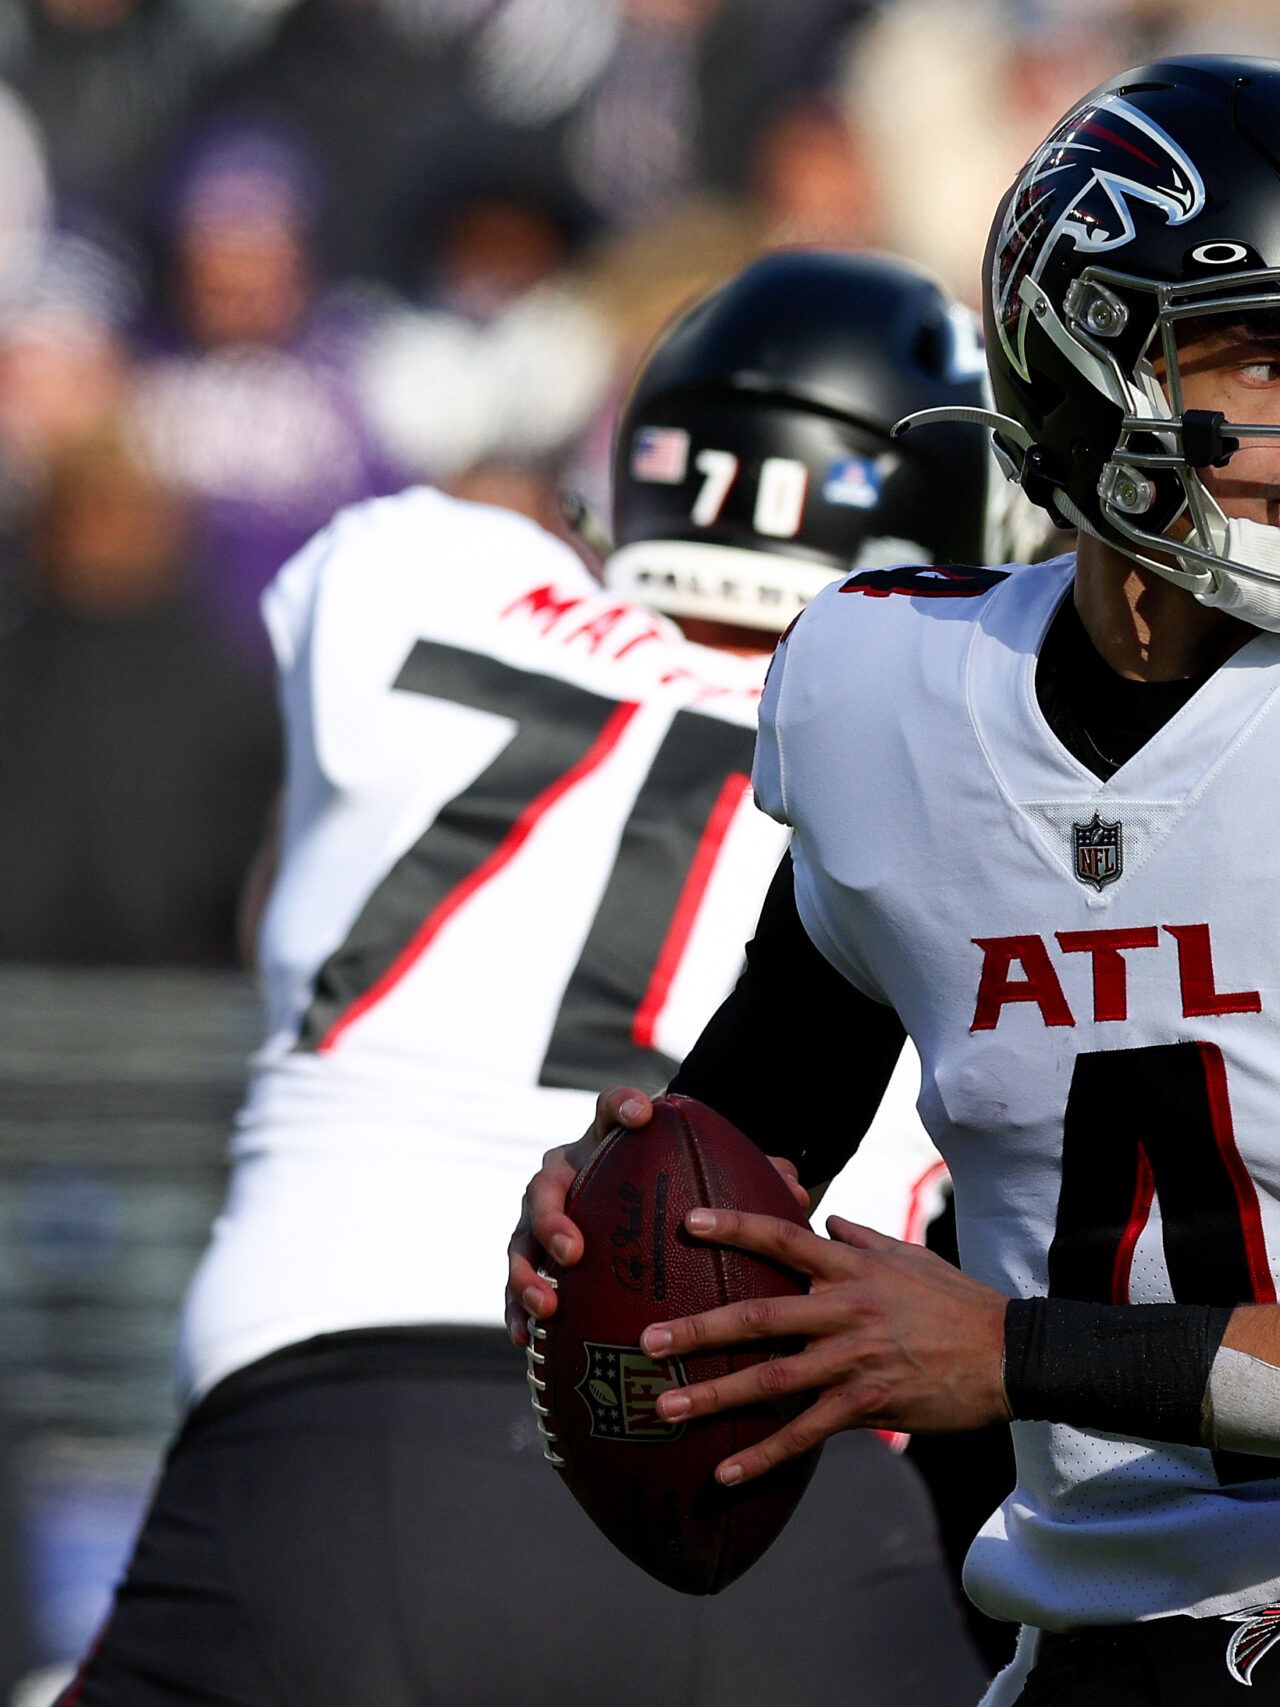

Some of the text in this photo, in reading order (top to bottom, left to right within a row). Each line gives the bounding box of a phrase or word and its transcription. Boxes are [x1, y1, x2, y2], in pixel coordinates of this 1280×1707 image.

[690, 449, 809, 538] 70
[1079, 847, 1115, 877] NFL
[970, 922, 1262, 1032] ATL
[623, 1355, 676, 1432] NFL
